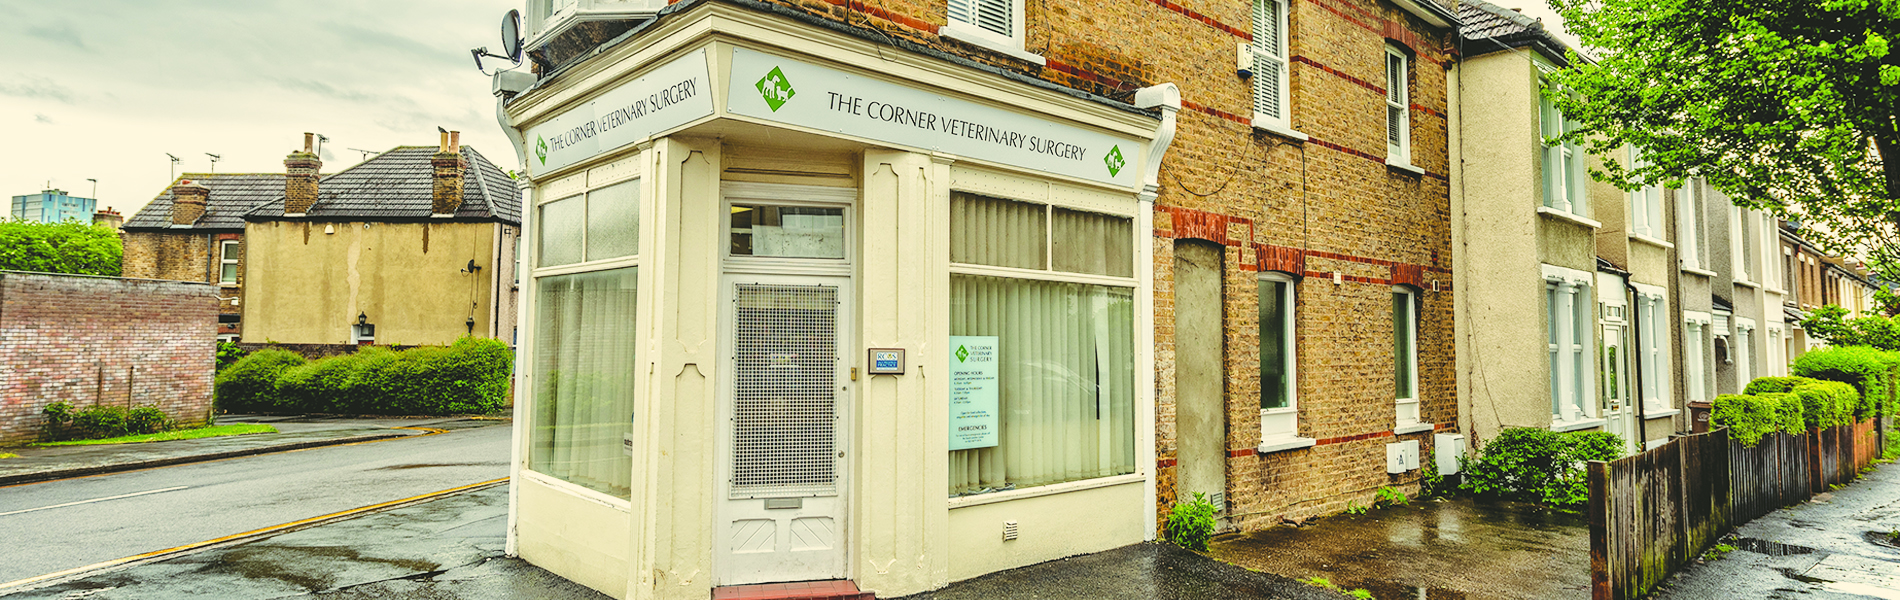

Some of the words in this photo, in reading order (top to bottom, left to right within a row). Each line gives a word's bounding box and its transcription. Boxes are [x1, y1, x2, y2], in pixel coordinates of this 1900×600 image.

[550, 134, 565, 152] THE
[565, 121, 597, 147] CORNER
[596, 98, 648, 133] VETERINARY
[650, 77, 697, 113] SURGERY
[828, 91, 862, 116] THE
[867, 101, 937, 131] CORNER
[941, 117, 1027, 149] VETERINARY
[1029, 135, 1086, 161] SURGERY
